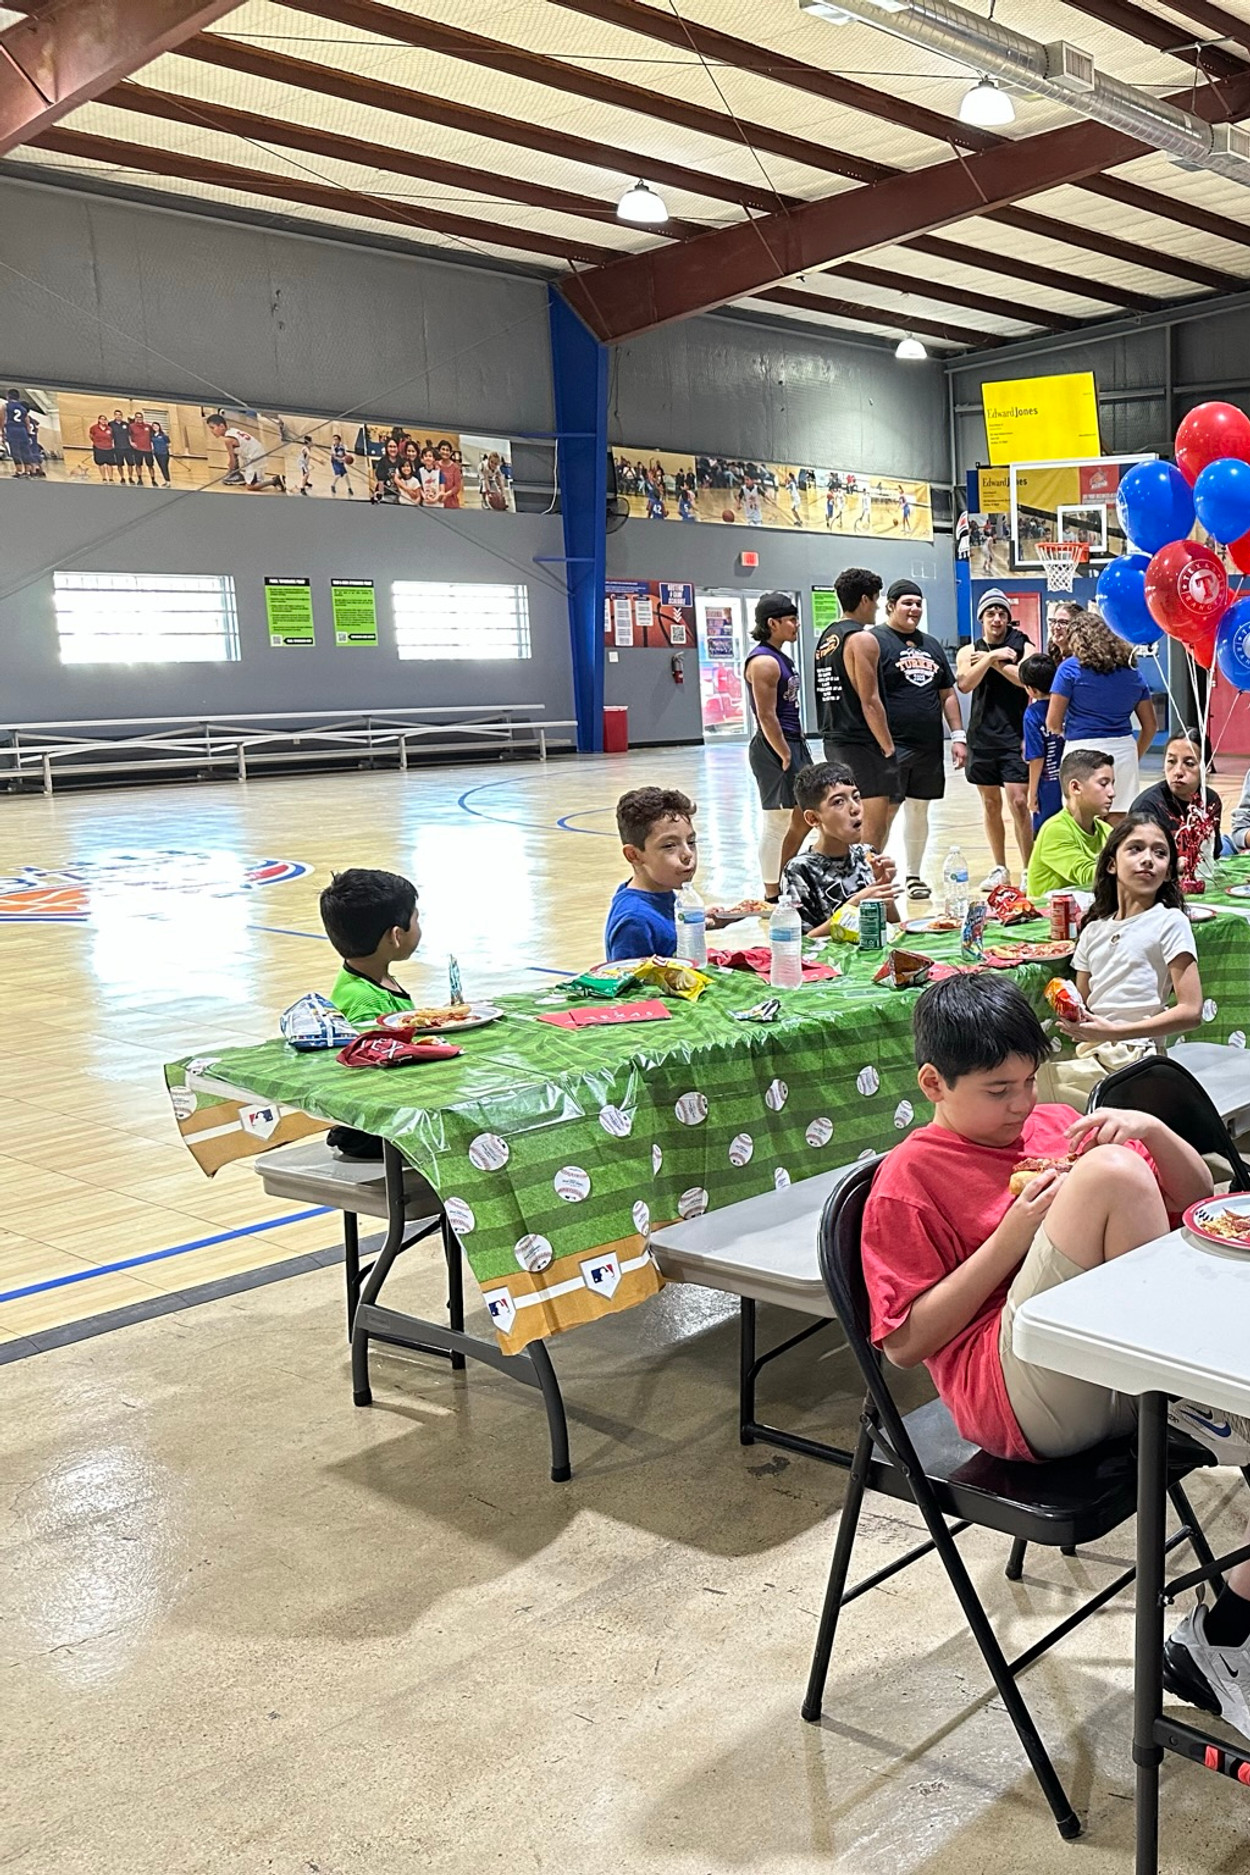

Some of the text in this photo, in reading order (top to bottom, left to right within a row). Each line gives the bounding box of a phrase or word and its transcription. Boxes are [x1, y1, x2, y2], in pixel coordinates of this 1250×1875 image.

[13, 408, 22, 423] 2
[652, 504, 663, 515] 42
[1194, 574, 1215, 601] T
